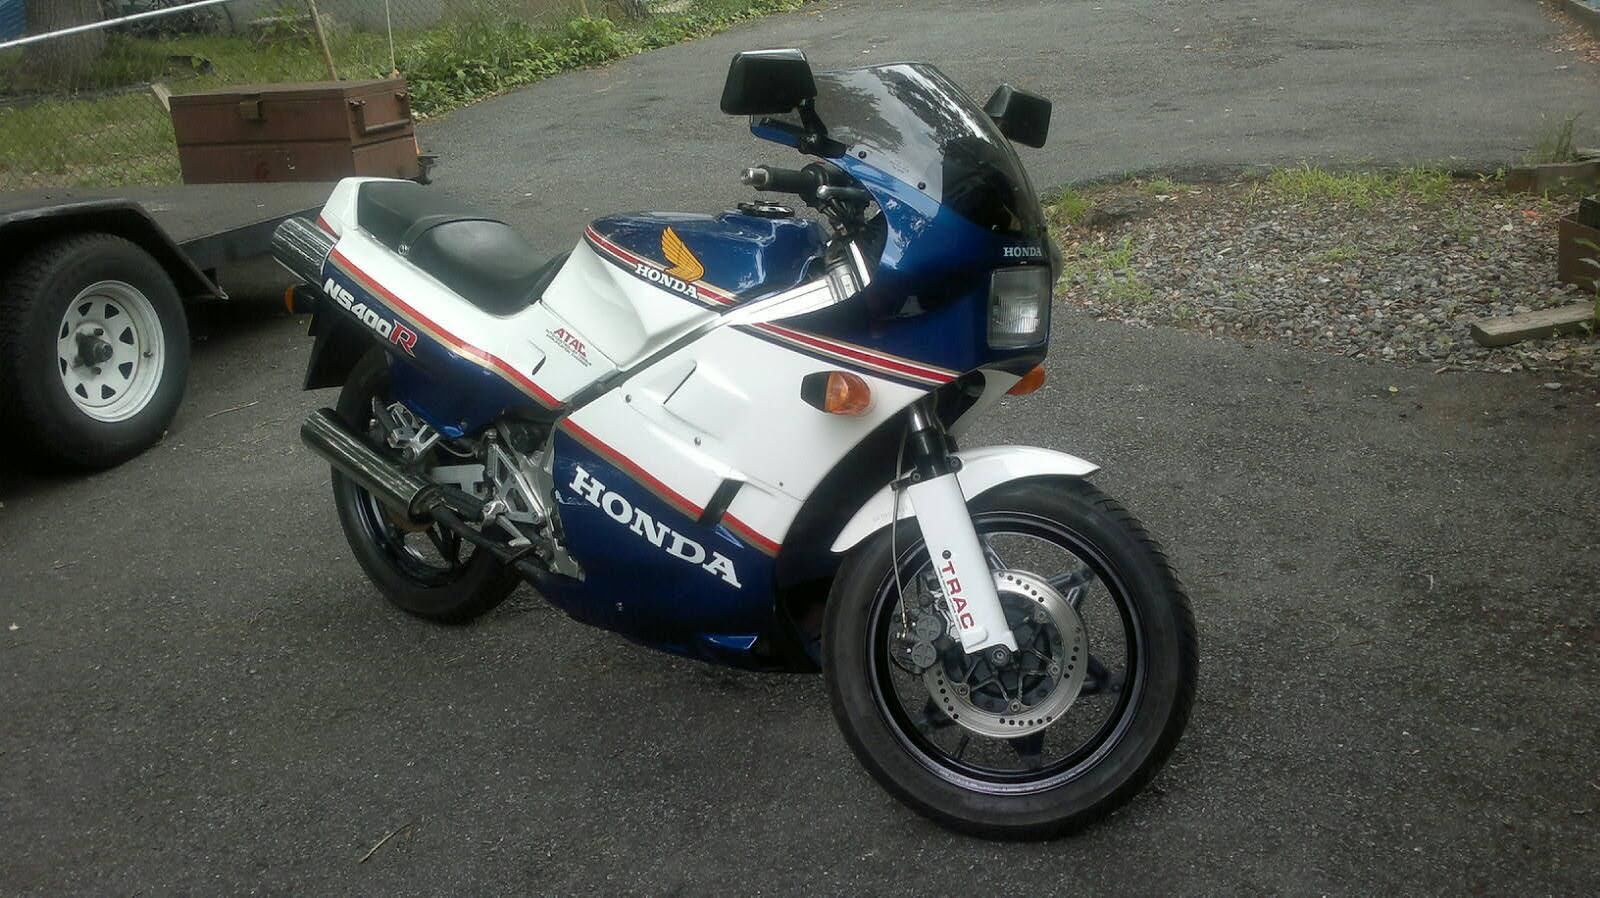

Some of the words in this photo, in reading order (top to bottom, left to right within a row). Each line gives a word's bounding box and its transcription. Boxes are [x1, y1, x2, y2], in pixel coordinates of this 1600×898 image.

[1003, 246, 1042, 257] HONDA
[634, 263, 699, 300] HONDA
[323, 278, 418, 358] NS400R
[553, 328, 587, 357] ATAC
[569, 465, 742, 589] HONDA
[942, 560, 975, 629] TRAC
